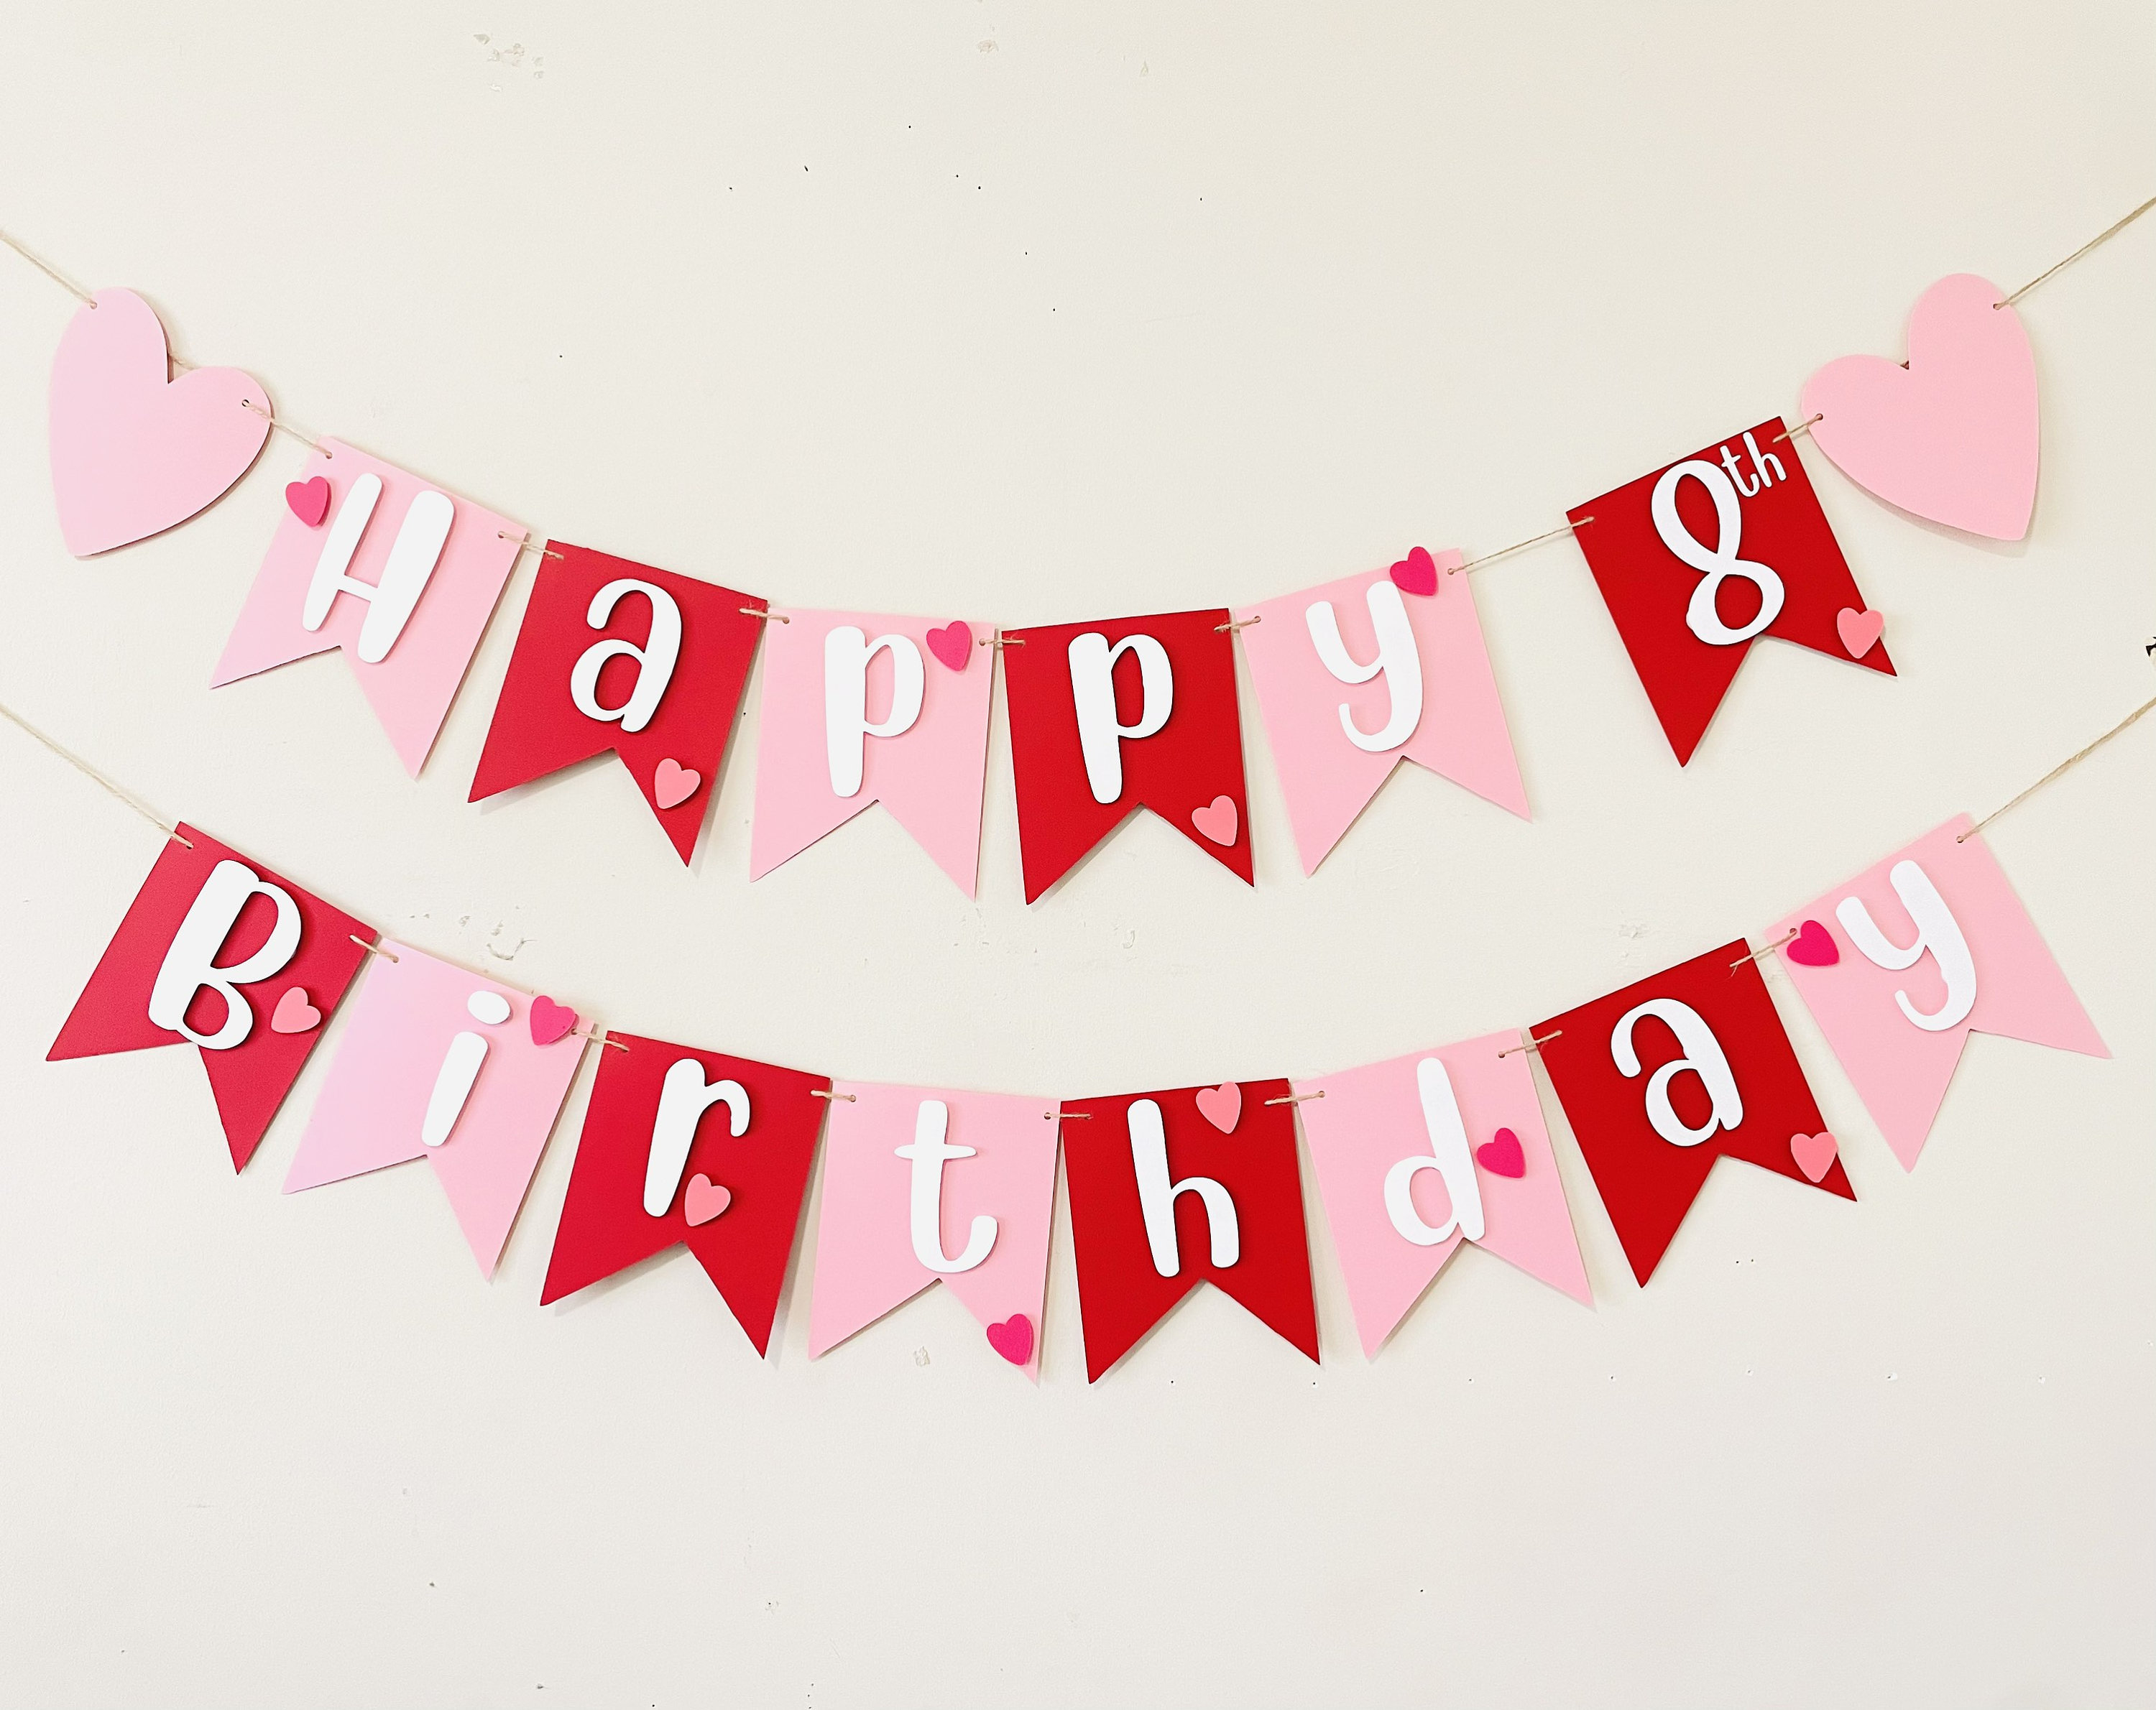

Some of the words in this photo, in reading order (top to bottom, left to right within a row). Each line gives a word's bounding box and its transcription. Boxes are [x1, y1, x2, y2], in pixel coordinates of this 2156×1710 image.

[302, 473, 1423, 804] Happy
[1652, 433, 1787, 645] 8th
[148, 860, 1977, 1277] Birthday
